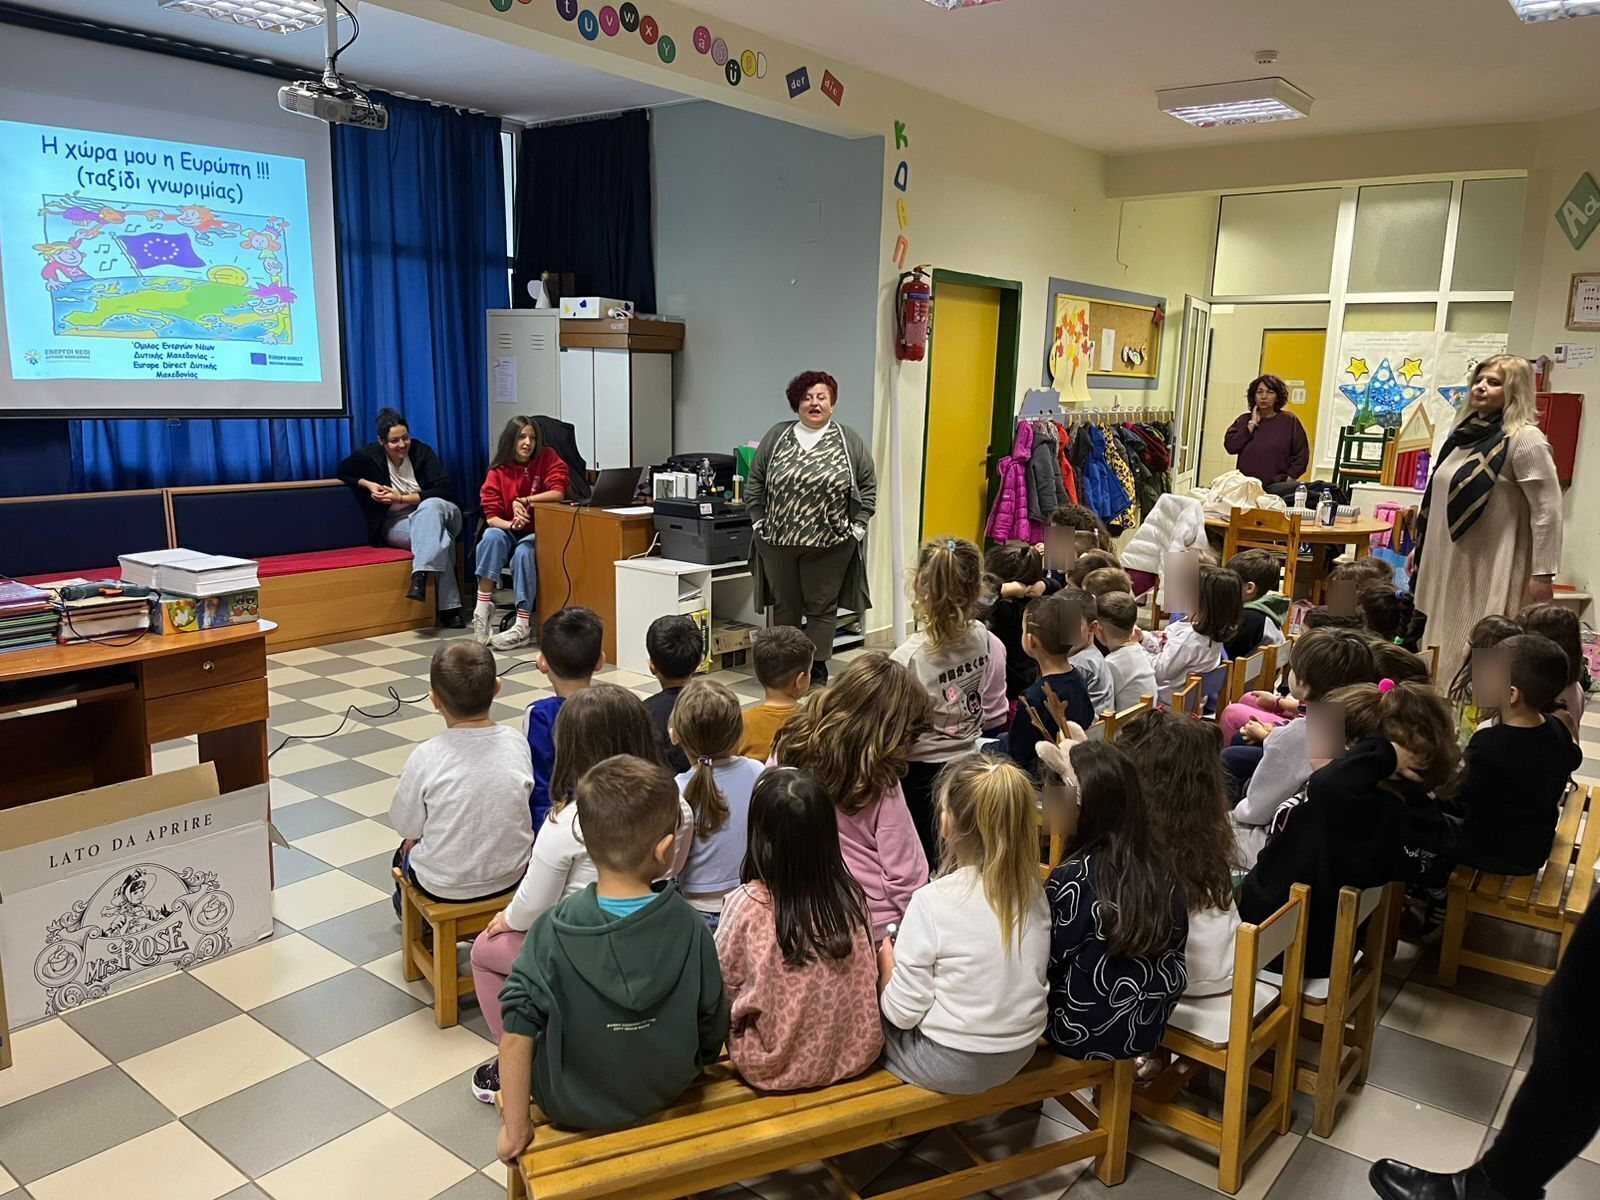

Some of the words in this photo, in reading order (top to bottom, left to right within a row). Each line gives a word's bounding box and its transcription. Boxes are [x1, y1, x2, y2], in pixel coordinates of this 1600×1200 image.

[790, 76, 805, 90] der
[41, 135, 58, 155] Η
[65, 140, 118, 164] χώρα
[124, 148, 157, 167] μου
[163, 154, 175, 171] η
[181, 152, 251, 180] Ευρώπη
[256, 161, 271, 180] !!!
[77, 165, 140, 191] (ταξίδι
[147, 178, 244, 205] γνωριμίας)
[162, 342, 193, 352] Ενεργών
[195, 343, 215, 351] Νέων
[134, 351, 164, 361] Δυτικής
[166, 352, 208, 361] Μακεδονίας
[133, 361, 160, 370] Europe
[162, 361, 187, 369] Direct
[189, 362, 218, 371] Δυτικής
[156, 370, 199, 379] Μακεδονίας
[49, 844, 100, 869] LATO
[111, 834, 137, 852] DA
[146, 813, 213, 843] APRIRE
[106, 920, 190, 971] ROSE
